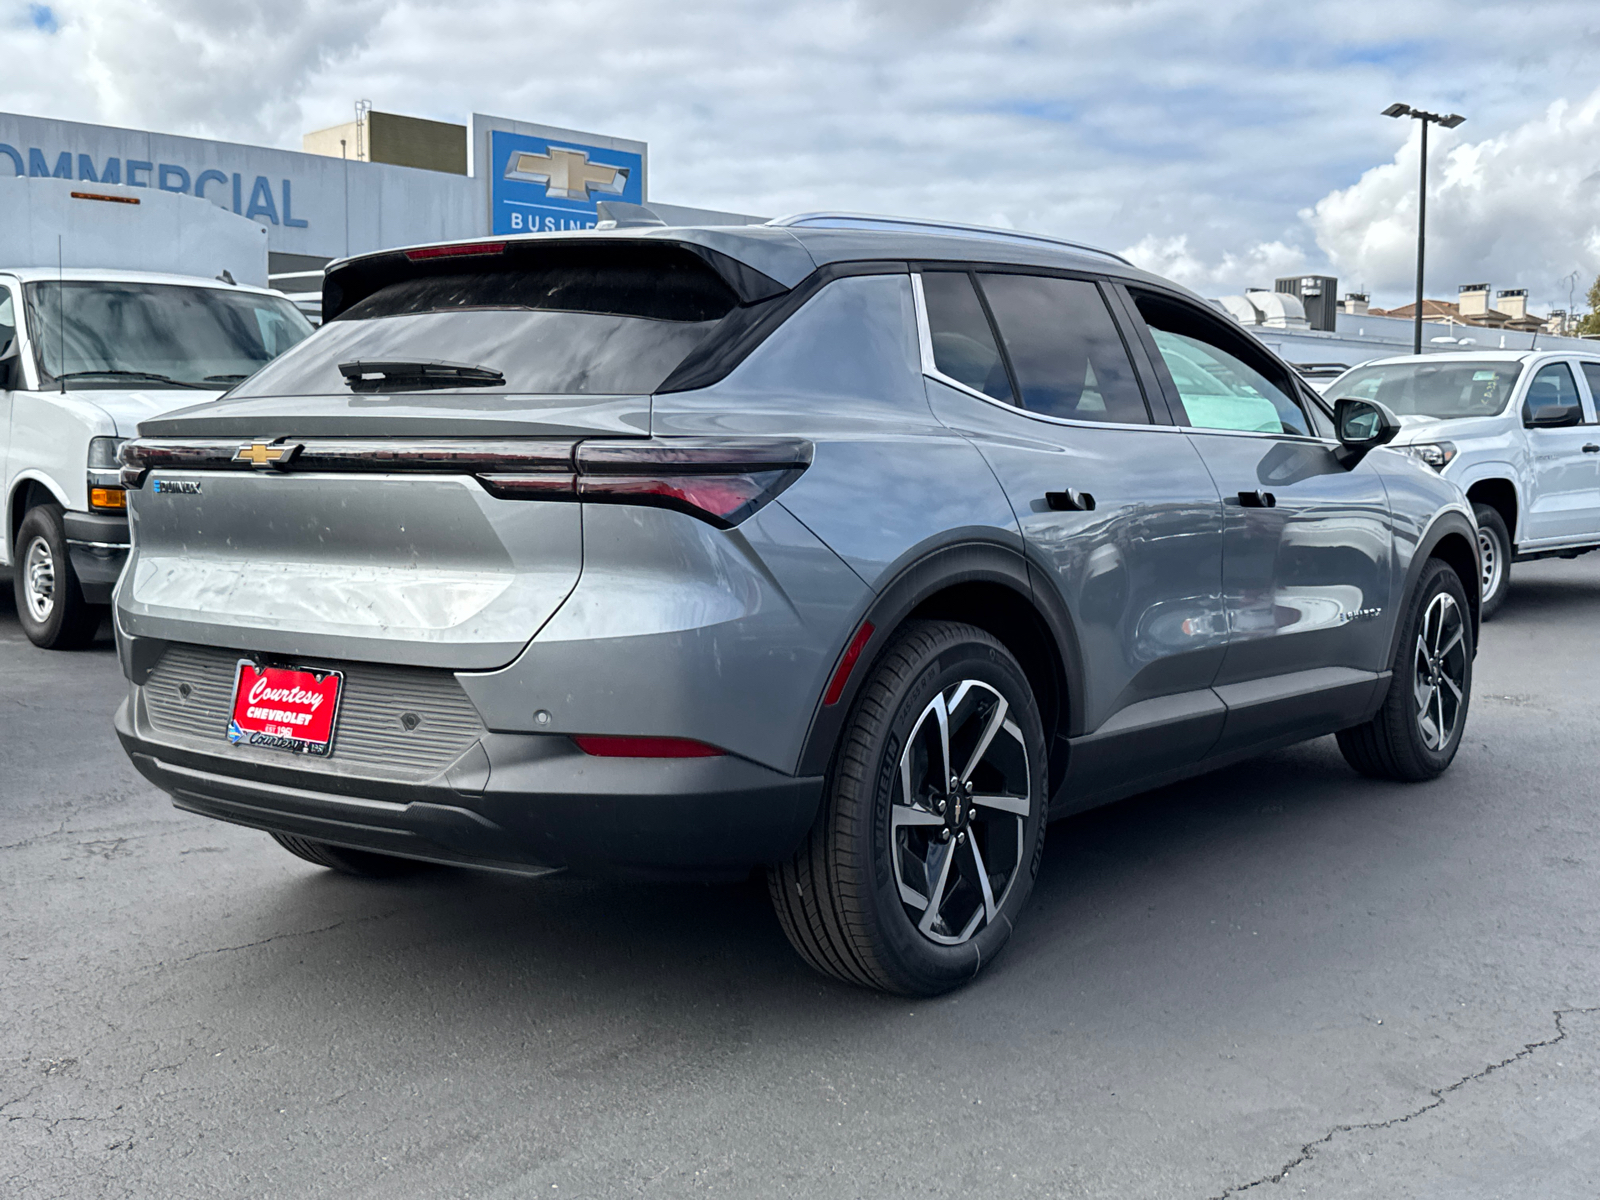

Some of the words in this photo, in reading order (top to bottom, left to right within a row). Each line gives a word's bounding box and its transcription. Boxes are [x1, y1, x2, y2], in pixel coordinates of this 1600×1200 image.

[248, 676, 324, 712] Courtesy
[246, 706, 313, 726] CHEVROLET
[875, 736, 898, 850] MICHELIN
